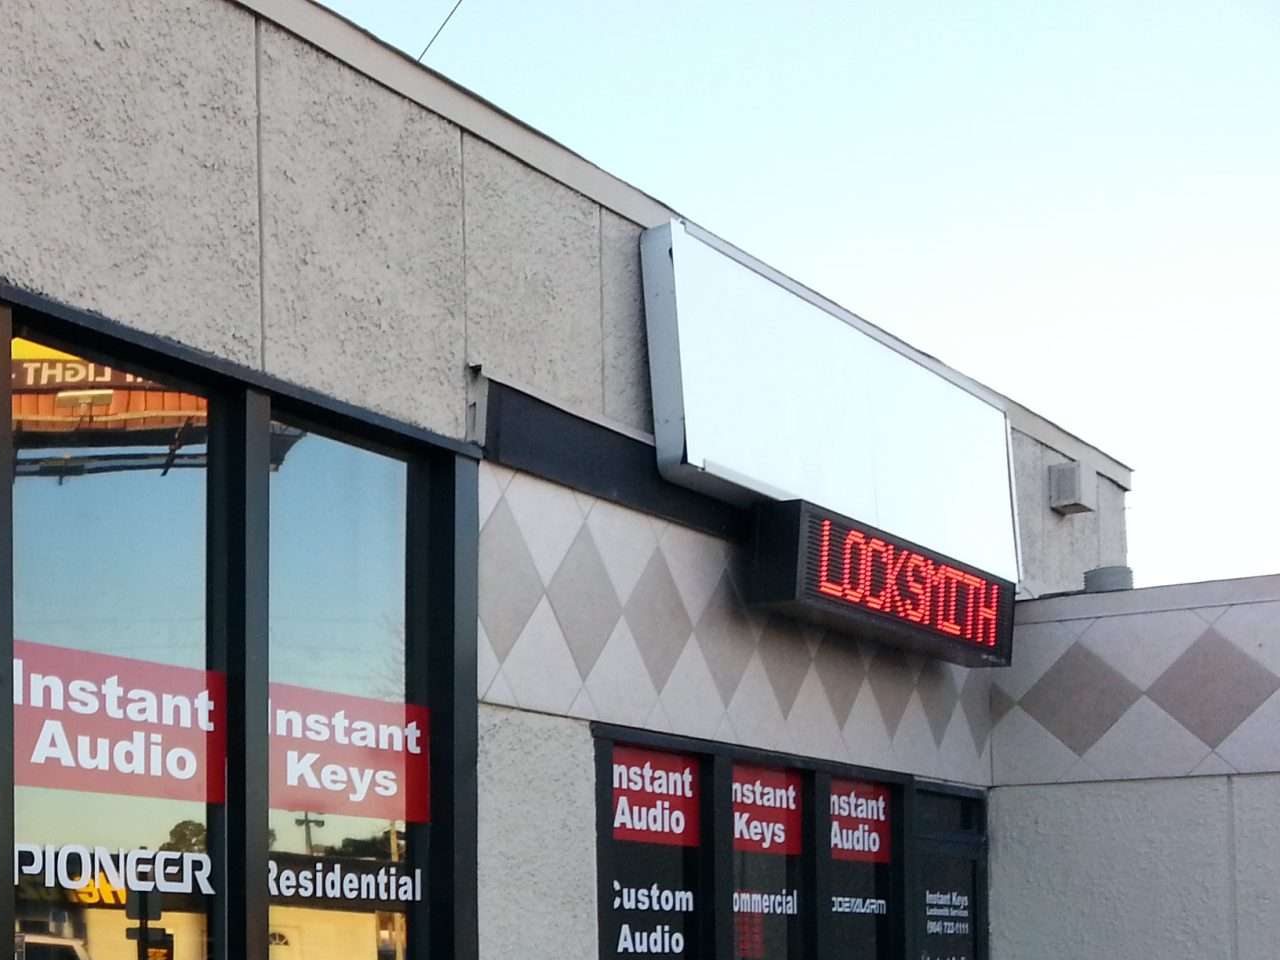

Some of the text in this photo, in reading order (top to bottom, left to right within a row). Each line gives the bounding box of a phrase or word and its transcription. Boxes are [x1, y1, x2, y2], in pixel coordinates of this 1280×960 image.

[819, 519, 1000, 647] LOCKSMITH
[12, 659, 215, 731] Instant
[269, 697, 422, 755] nstant
[30, 720, 198, 780] Audio
[286, 750, 399, 802] Keys
[613, 760, 694, 798] nstant
[732, 779, 797, 810] nstant
[613, 796, 686, 834] Audio
[830, 791, 886, 821] nstant
[734, 811, 786, 849] Keys
[831, 820, 880, 853] Audio
[14, 843, 217, 896] PIONEER
[269, 862, 422, 902] Residential
[732, 888, 799, 915] ommercial
[616, 924, 685, 954] Audio
